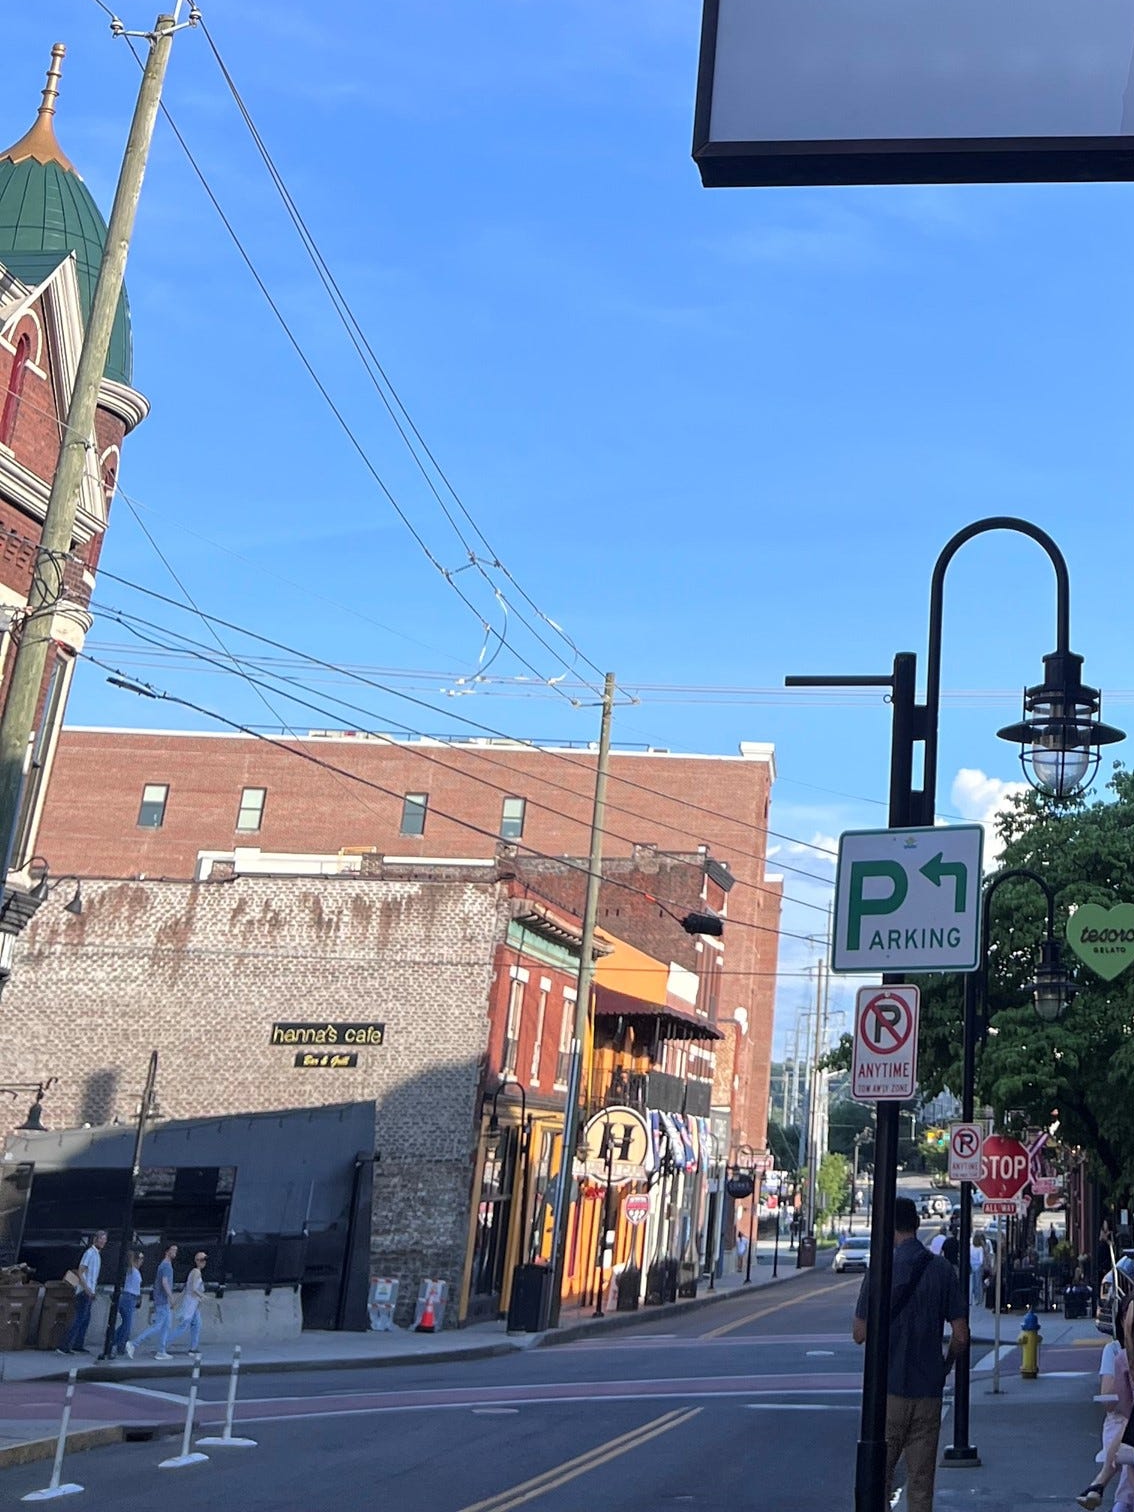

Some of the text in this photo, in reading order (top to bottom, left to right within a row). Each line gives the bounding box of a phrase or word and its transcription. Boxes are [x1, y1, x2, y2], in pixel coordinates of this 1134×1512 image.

[345, 1026, 381, 1044] cafe
[858, 1063, 910, 1078] ANYTIME
[981, 1155, 1026, 1179] STOP
[985, 1204, 1015, 1213] ALL WAY
